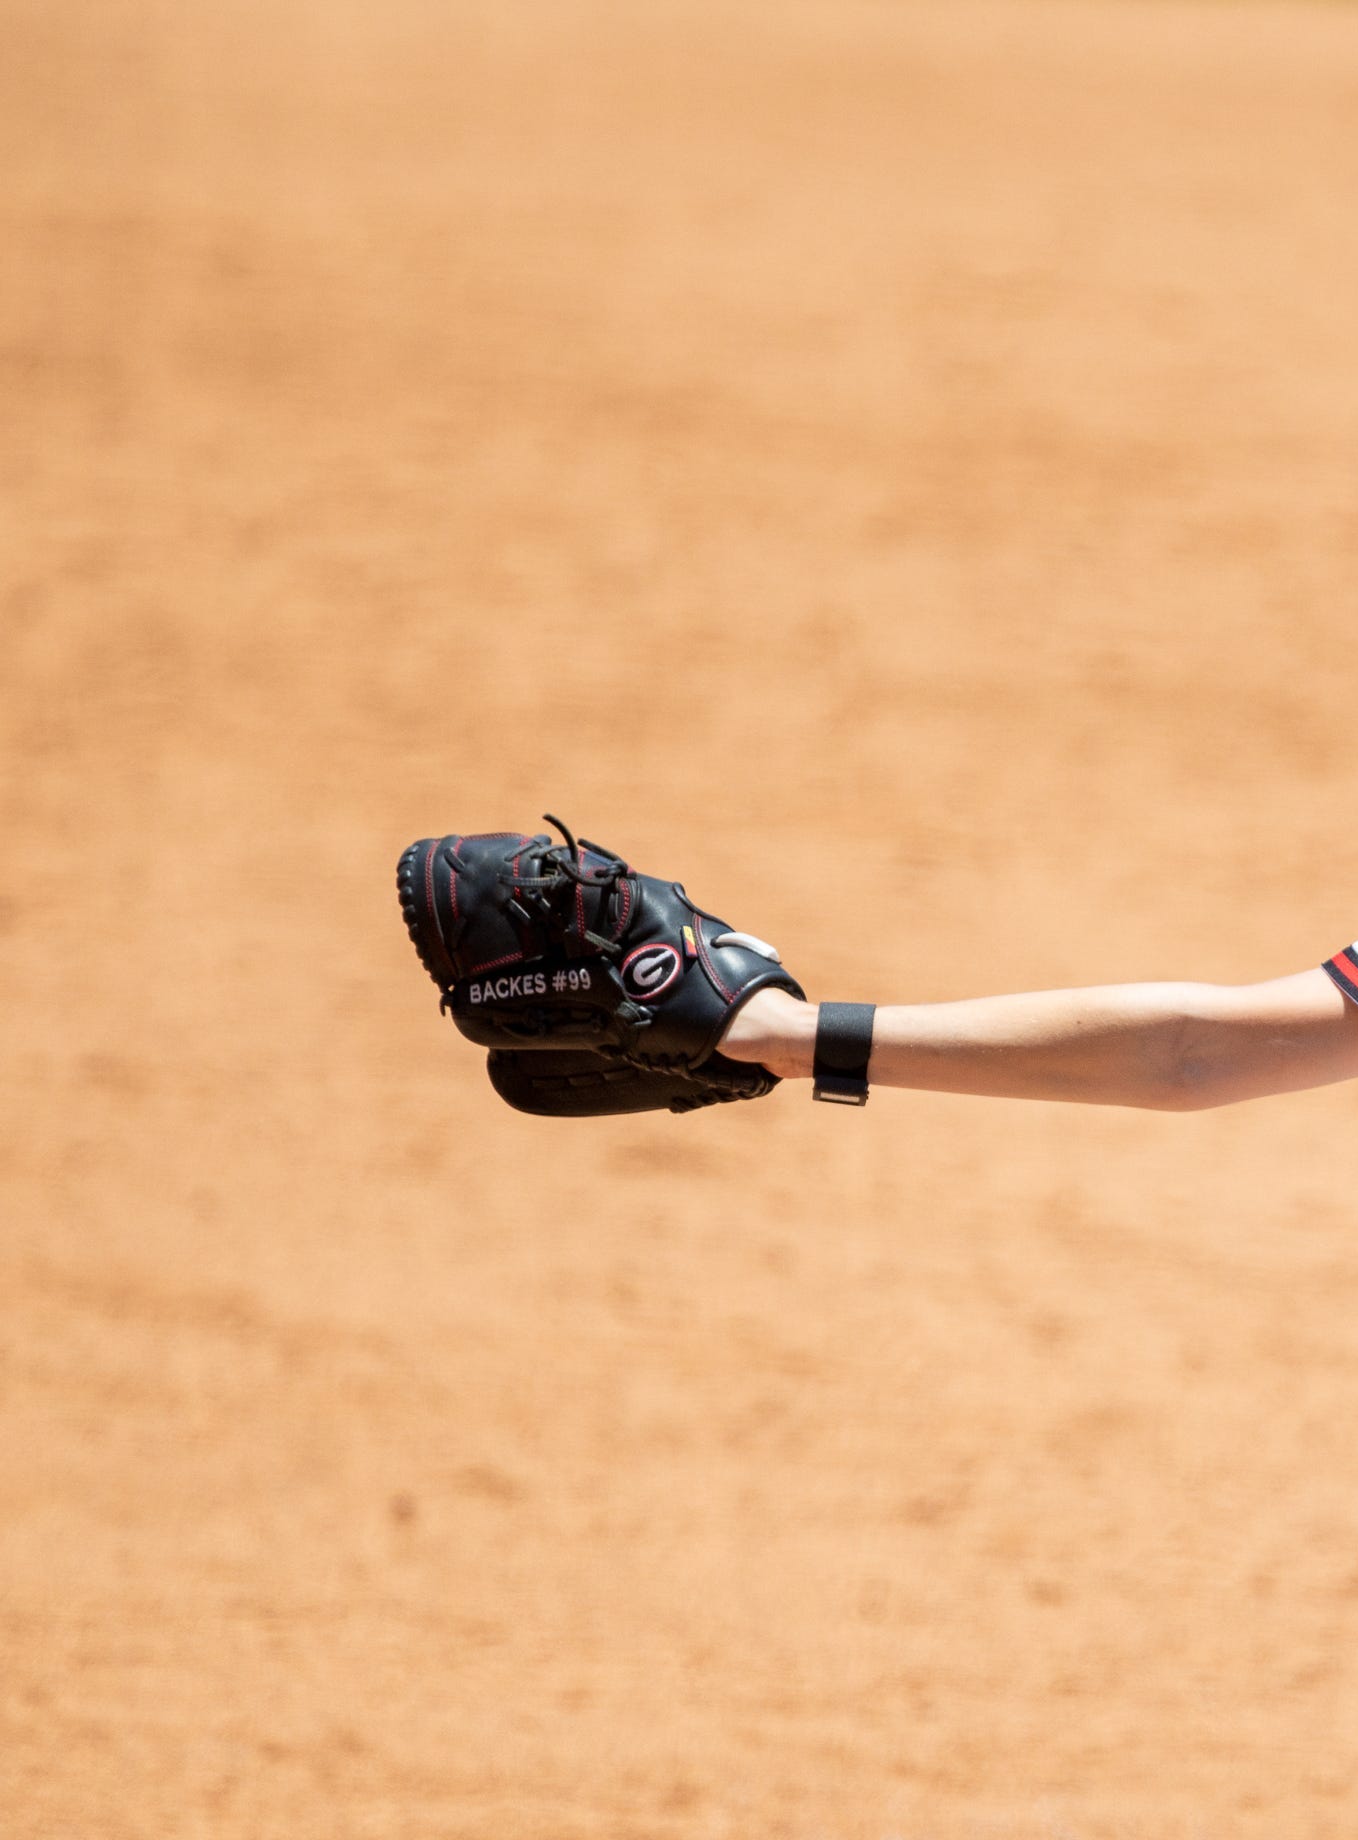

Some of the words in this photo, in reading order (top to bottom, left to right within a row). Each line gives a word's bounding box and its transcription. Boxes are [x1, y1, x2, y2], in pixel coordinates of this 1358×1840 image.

[469, 972, 547, 1004] BACKES
[552, 967, 592, 992] #99
[632, 949, 674, 987] G
